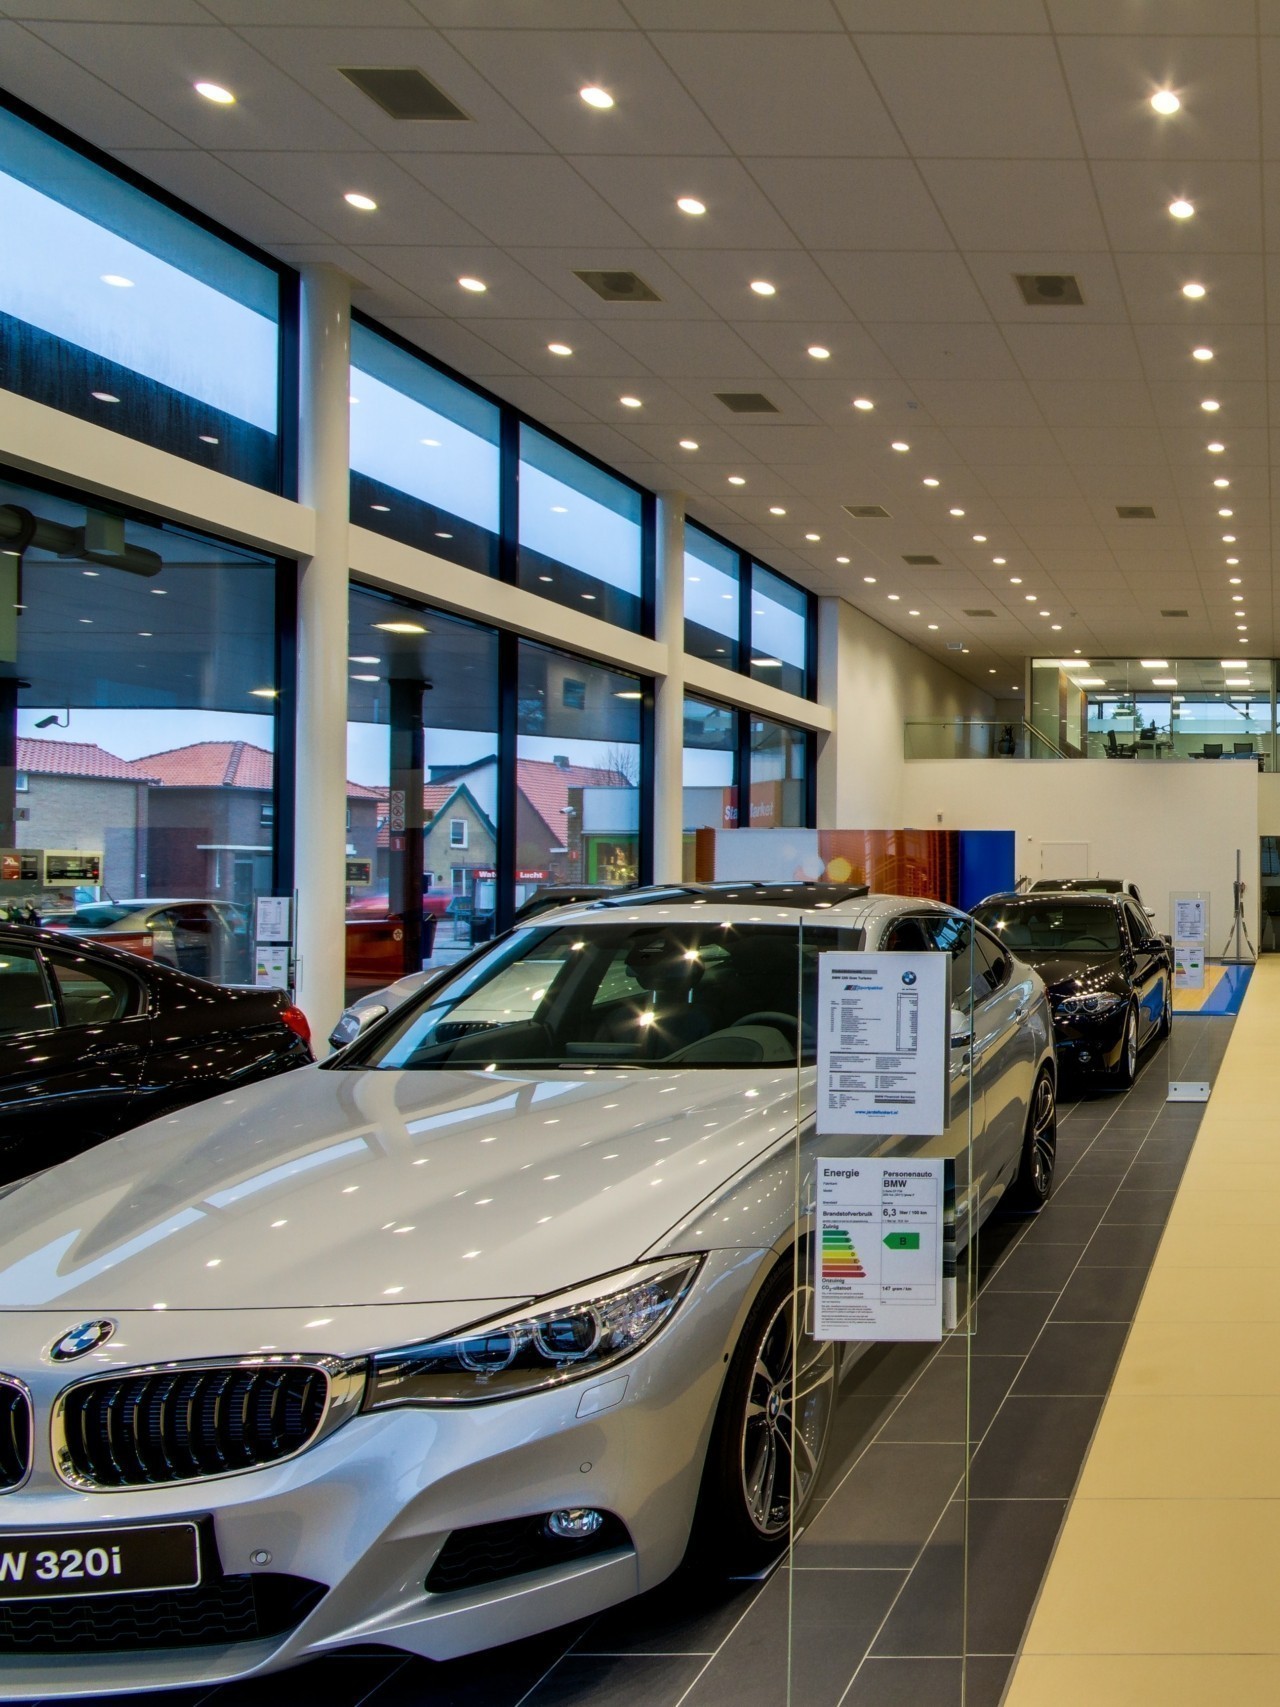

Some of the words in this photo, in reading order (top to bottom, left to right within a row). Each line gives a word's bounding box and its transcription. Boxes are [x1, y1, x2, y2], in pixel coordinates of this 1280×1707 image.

[724, 805, 738, 820] Sta
[519, 871, 543, 879] Lucht
[823, 1168, 860, 1179] Energie
[883, 1170, 933, 1178] Personenauto
[883, 1179, 907, 1188] BMW
[882, 1208, 897, 1218] 6,3
[900, 1237, 907, 1246] B
[36, 1546, 122, 1581] 320i
